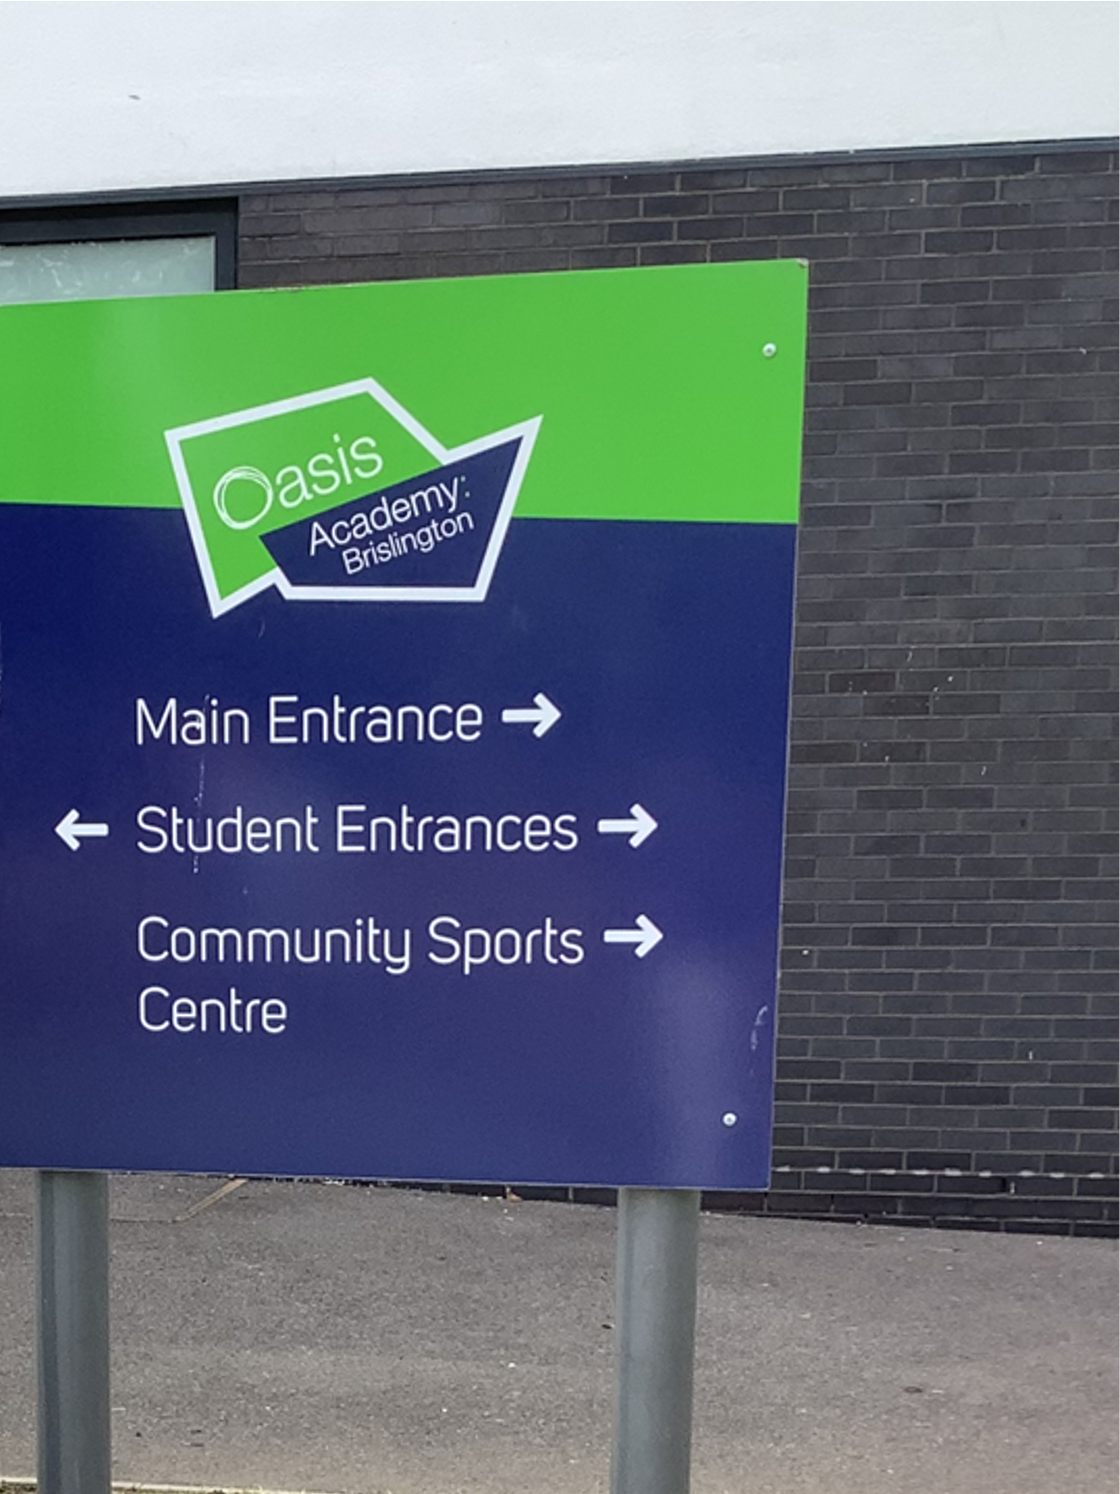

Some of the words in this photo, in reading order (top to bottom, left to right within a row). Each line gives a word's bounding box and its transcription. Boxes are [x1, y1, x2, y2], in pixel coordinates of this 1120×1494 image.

[212, 430, 384, 531] Oasis
[308, 474, 472, 555] Academy:
[343, 508, 474, 575] Brislington
[136, 697, 249, 746] Main
[269, 695, 482, 743] Entrance
[136, 807, 319, 853] Student
[336, 804, 579, 853] Entrances
[137, 916, 411, 974] Community
[428, 915, 585, 975] Sports
[138, 987, 288, 1034] Centre
